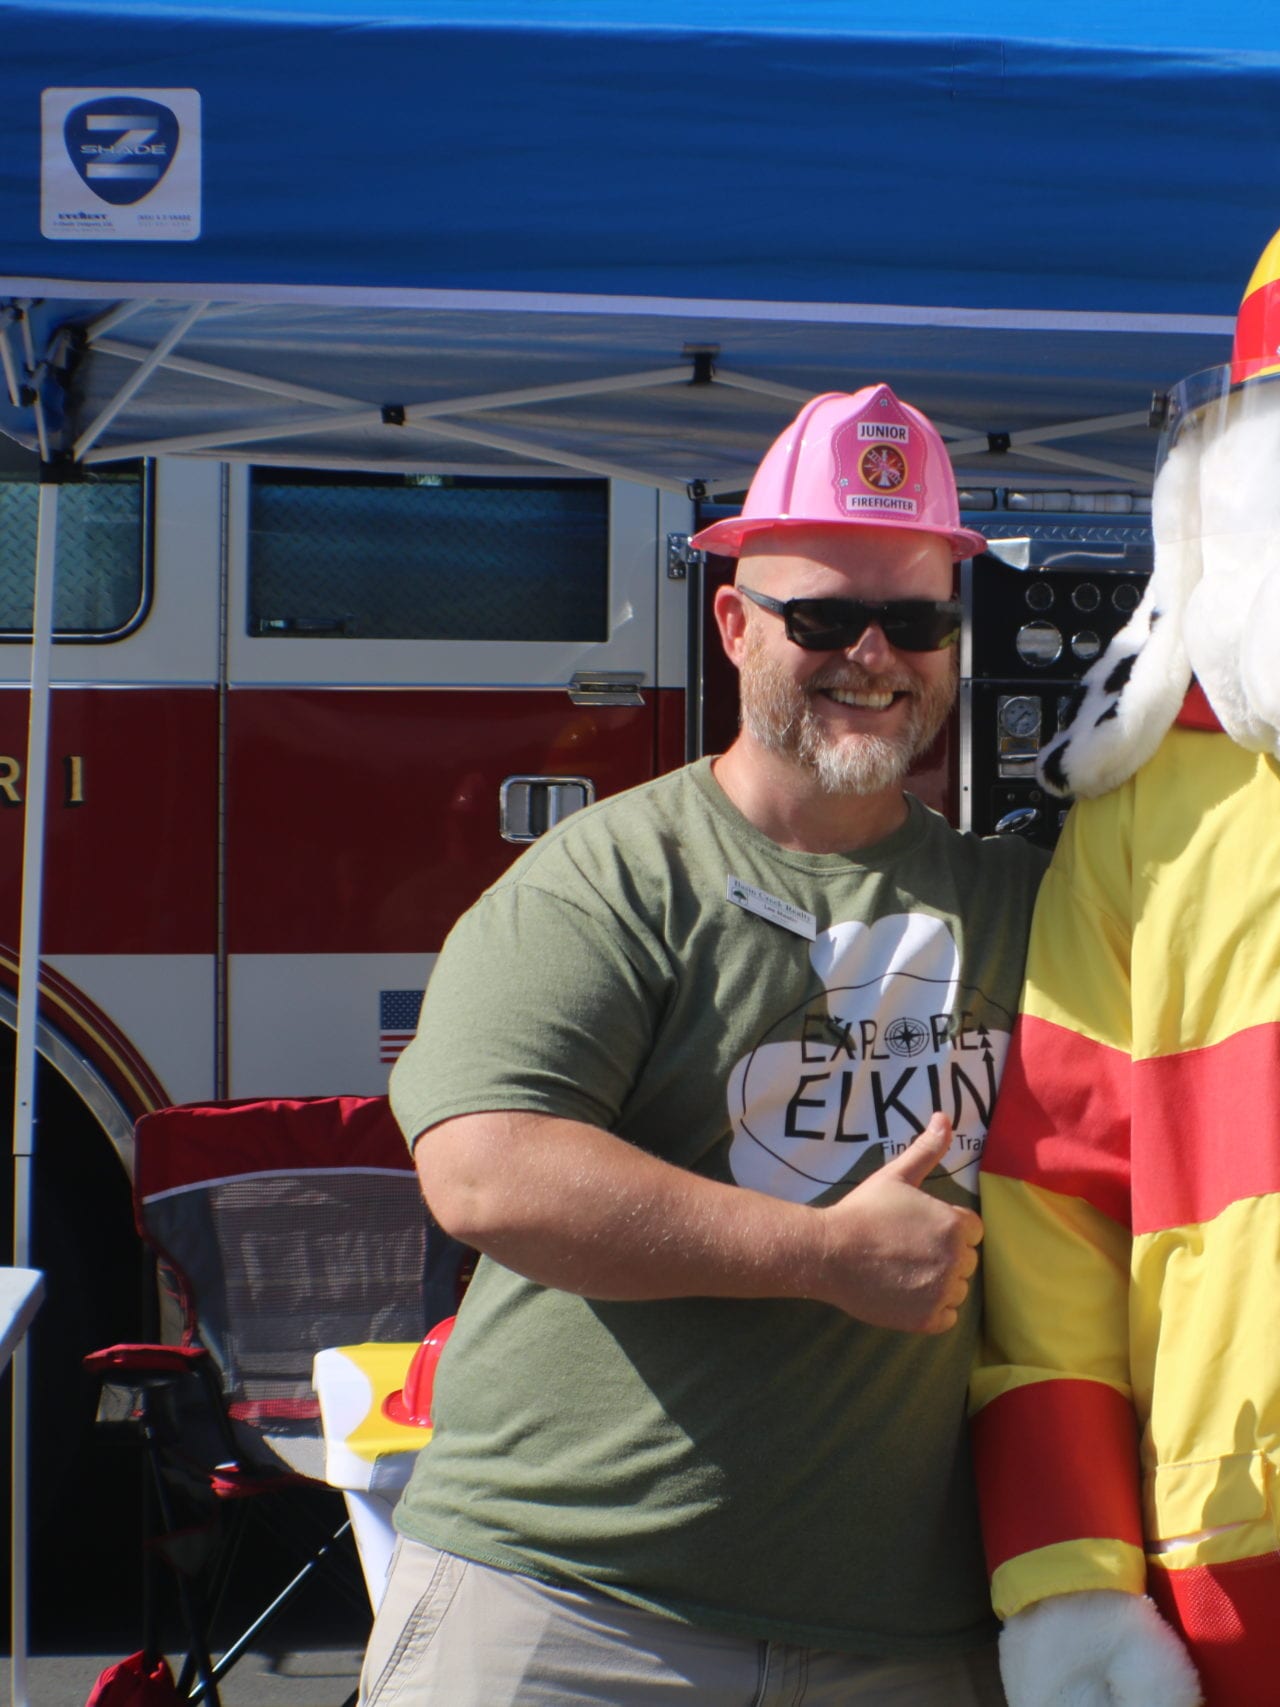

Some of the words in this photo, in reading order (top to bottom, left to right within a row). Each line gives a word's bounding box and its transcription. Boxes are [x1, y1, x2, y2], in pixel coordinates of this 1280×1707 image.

[80, 144, 167, 155] SHADE
[85, 115, 160, 178] Z
[860, 424, 907, 440] JUNIOR
[851, 497, 914, 512] FIREFIGHTER
[784, 1056, 998, 1143] ELKIN
